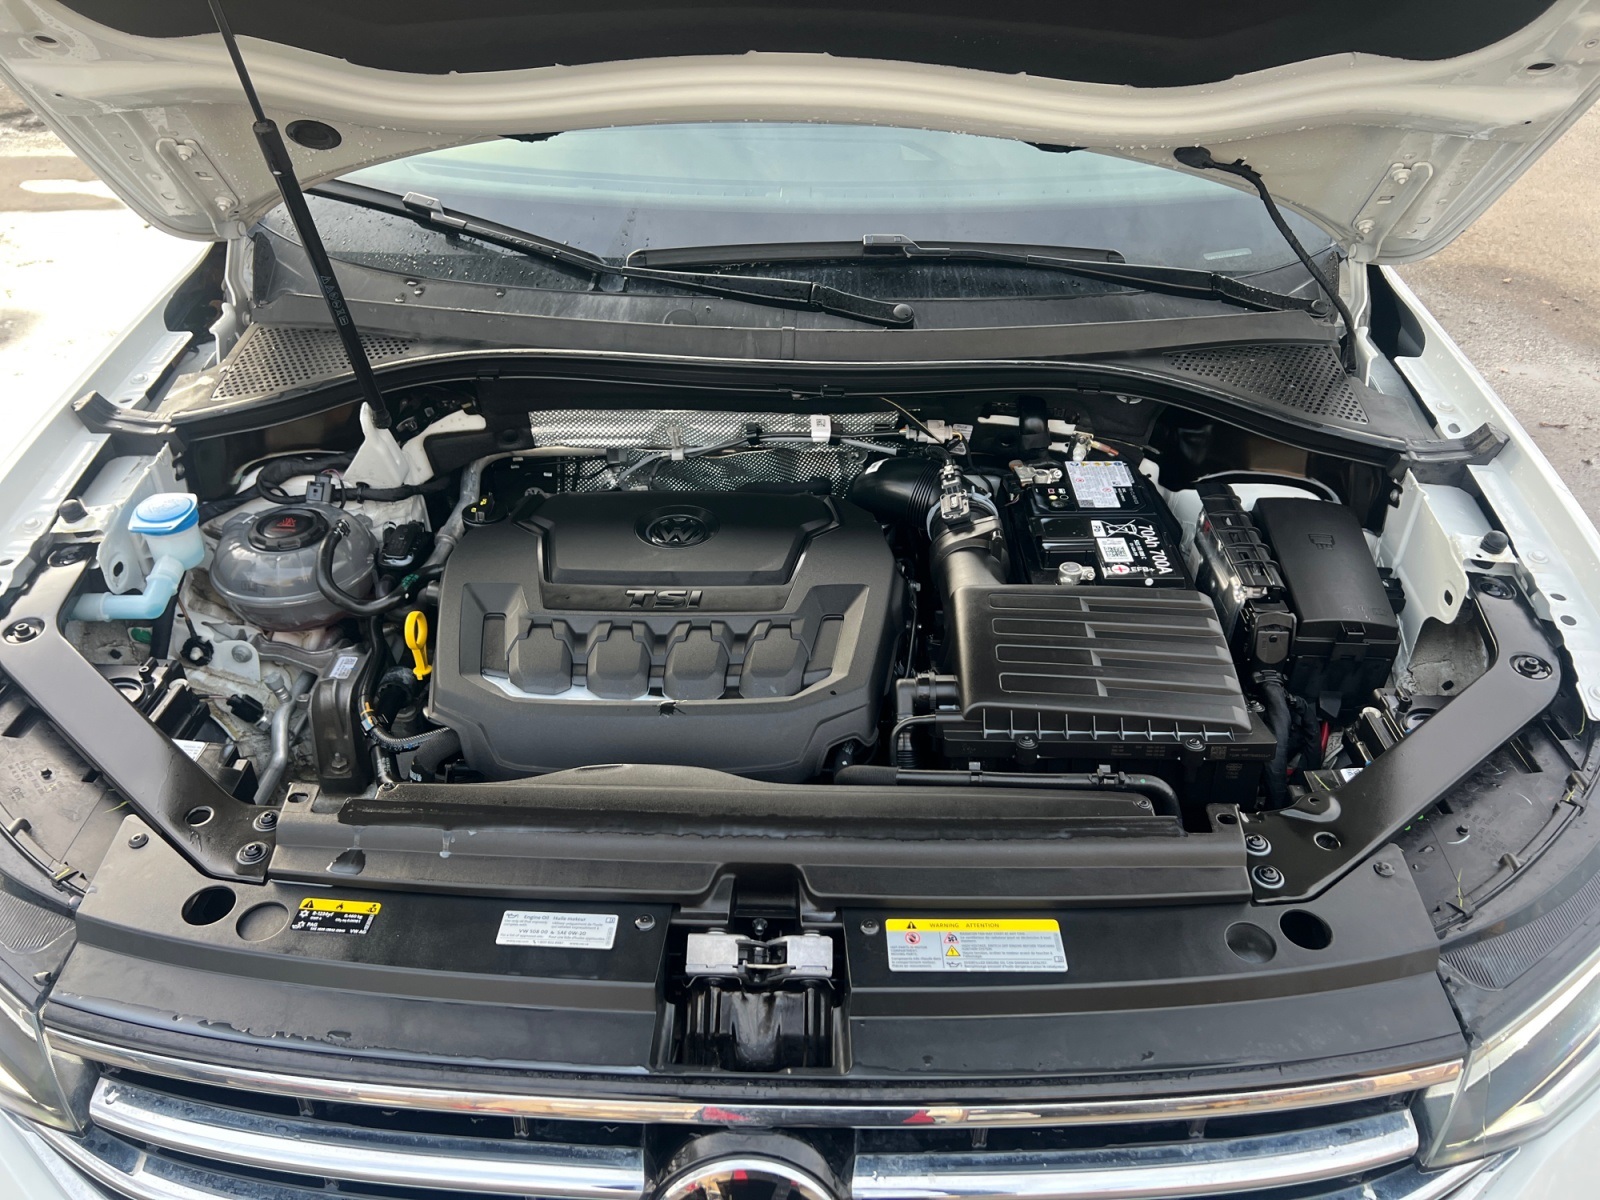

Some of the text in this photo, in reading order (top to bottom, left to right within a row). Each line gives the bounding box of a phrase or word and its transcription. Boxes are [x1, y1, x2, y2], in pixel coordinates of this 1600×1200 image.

[1138, 525, 1161, 548] 70Ah
[1149, 550, 1173, 574] 700A
[625, 589, 703, 609] TSI
